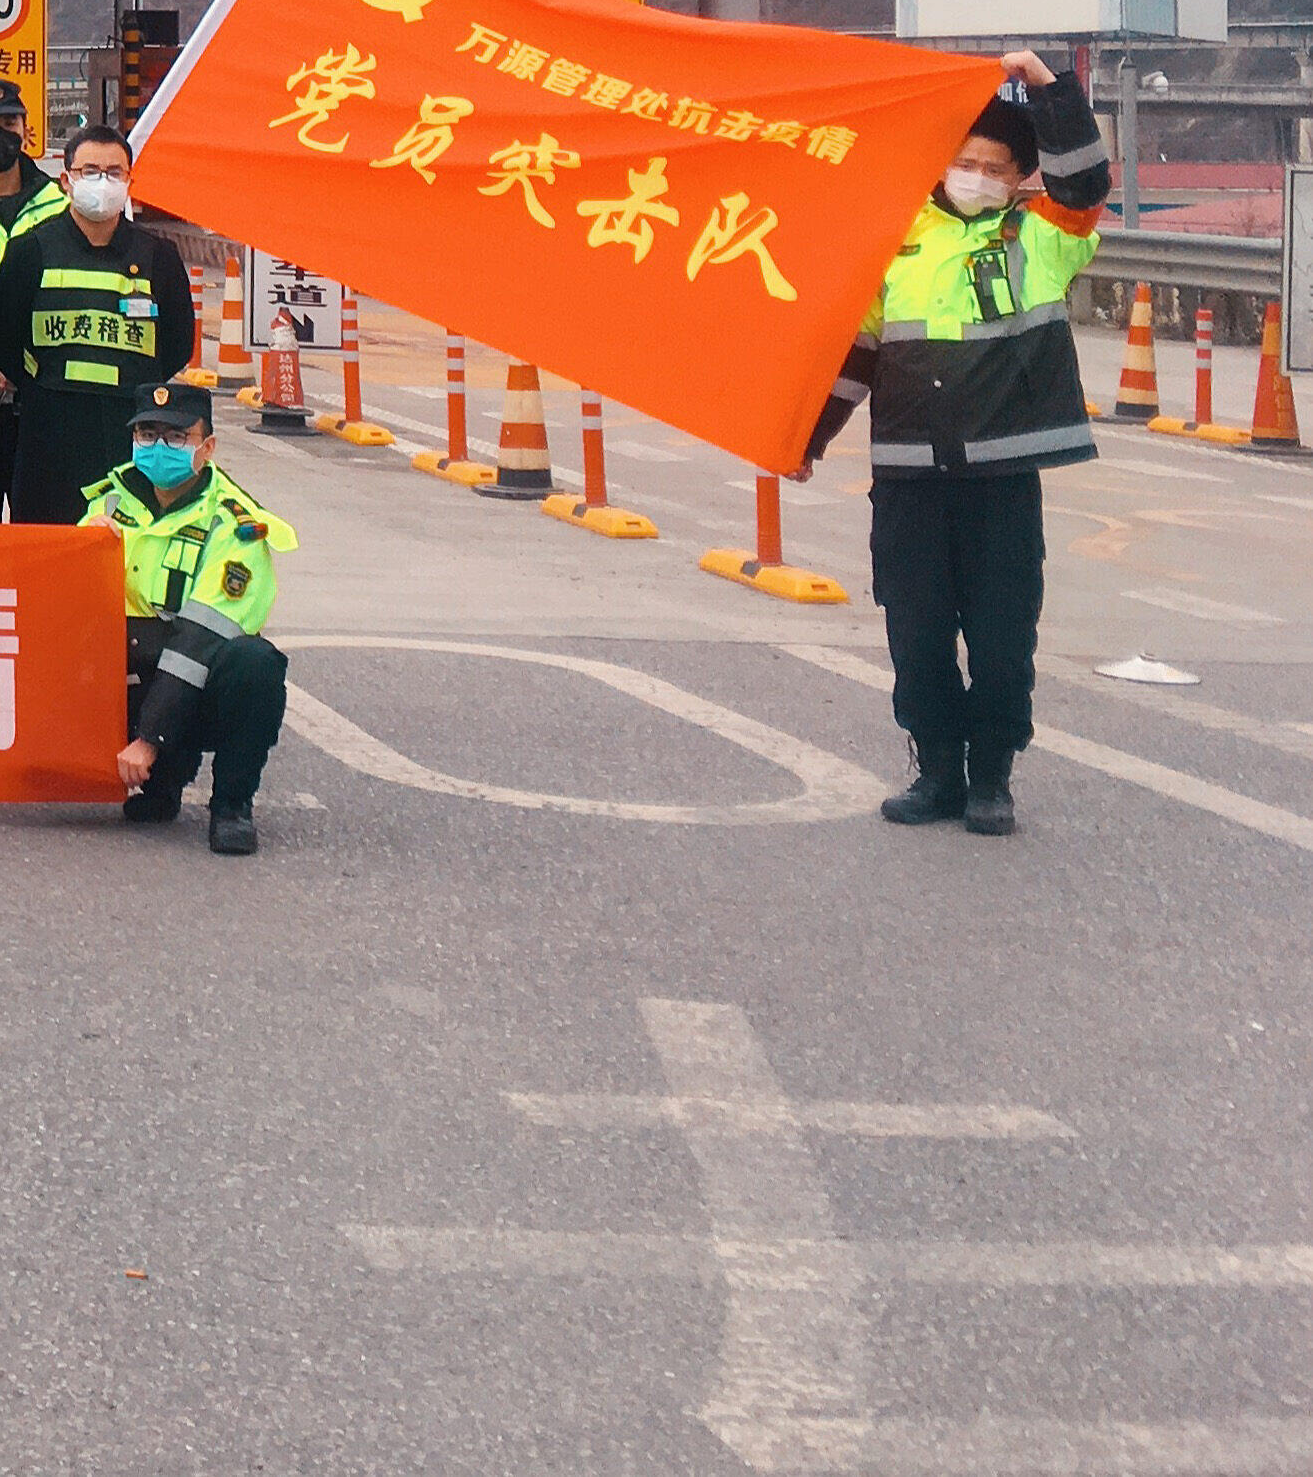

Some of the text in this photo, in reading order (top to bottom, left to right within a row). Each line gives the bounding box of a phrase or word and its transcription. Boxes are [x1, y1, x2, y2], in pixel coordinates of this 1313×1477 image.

[457, 22, 858, 165] 万源管理处抗击疫情
[267, 41, 798, 303] 党员突击队
[44, 314, 144, 348] 收费稽查
